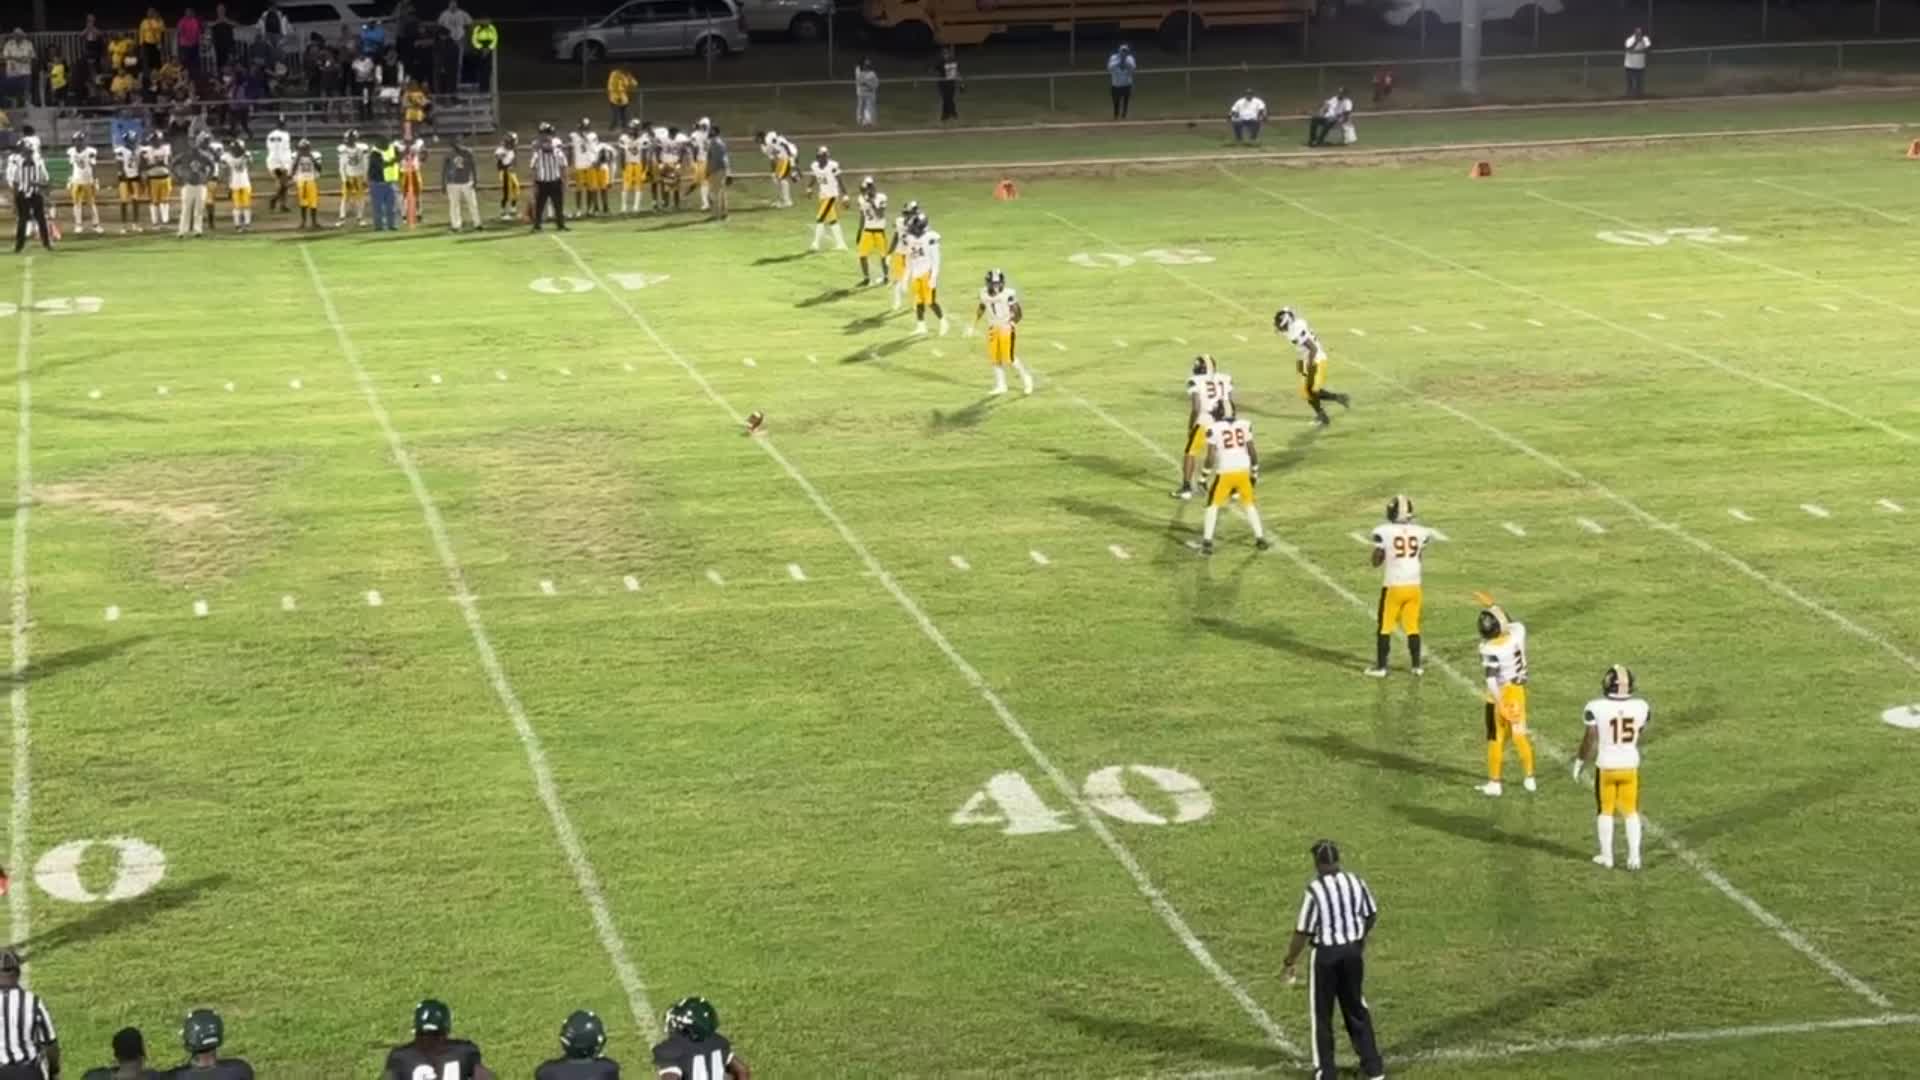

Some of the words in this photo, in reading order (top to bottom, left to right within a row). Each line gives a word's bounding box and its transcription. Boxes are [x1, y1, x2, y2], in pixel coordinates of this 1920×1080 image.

[1205, 381, 1225, 400] 31
[1222, 428, 1245, 450] 28
[1393, 535, 1419, 559] 99
[1609, 716, 1635, 745] 15
[951, 764, 1214, 835] 40
